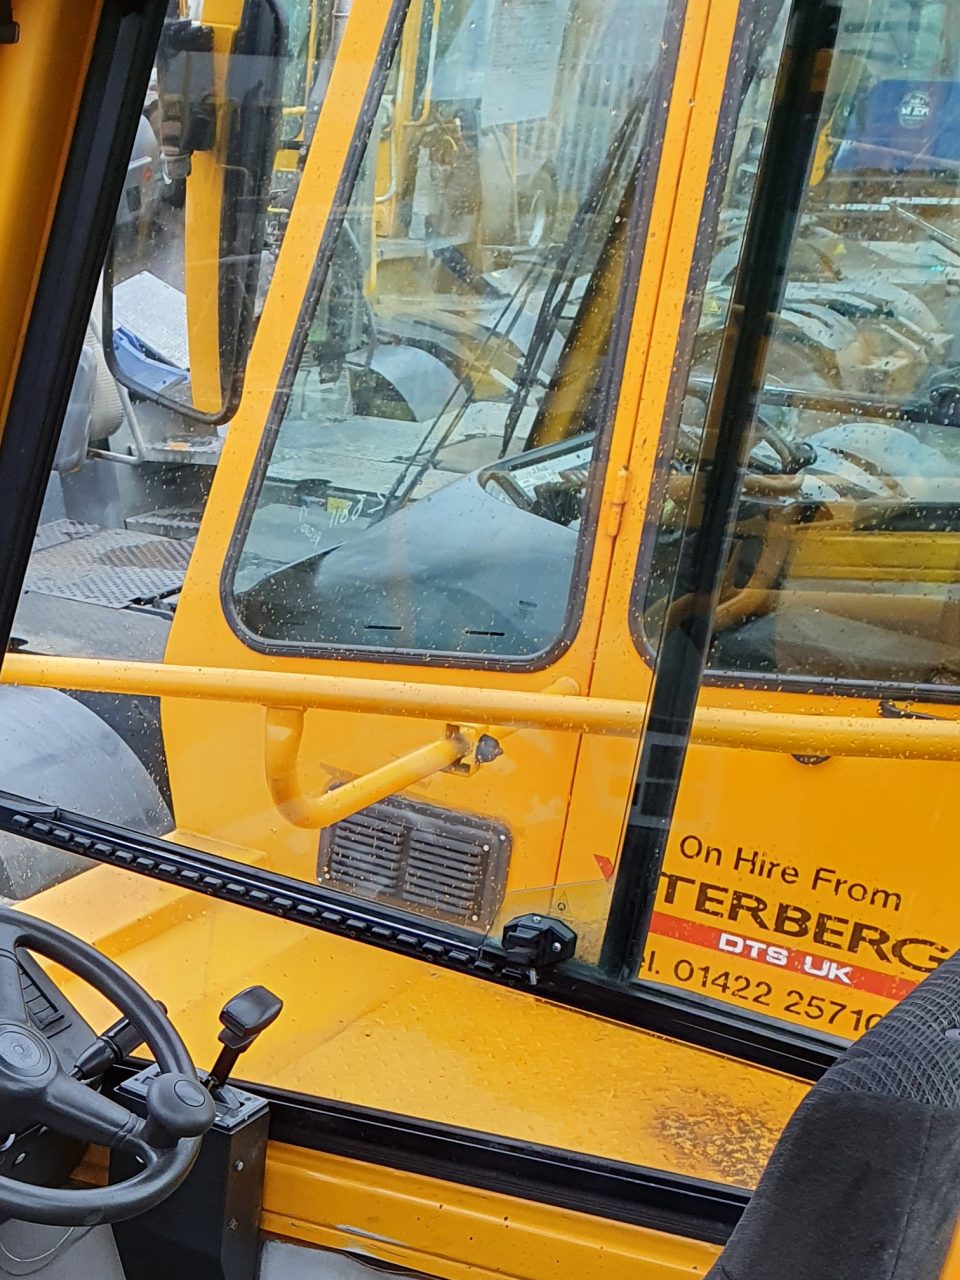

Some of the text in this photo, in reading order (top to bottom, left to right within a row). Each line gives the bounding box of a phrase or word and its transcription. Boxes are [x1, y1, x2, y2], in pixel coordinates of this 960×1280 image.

[679, 834, 902, 911] On Hire From
[660, 872, 950, 974] TERBERG
[674, 959, 773, 1006] 01422
[718, 932, 854, 984] DTS UK
